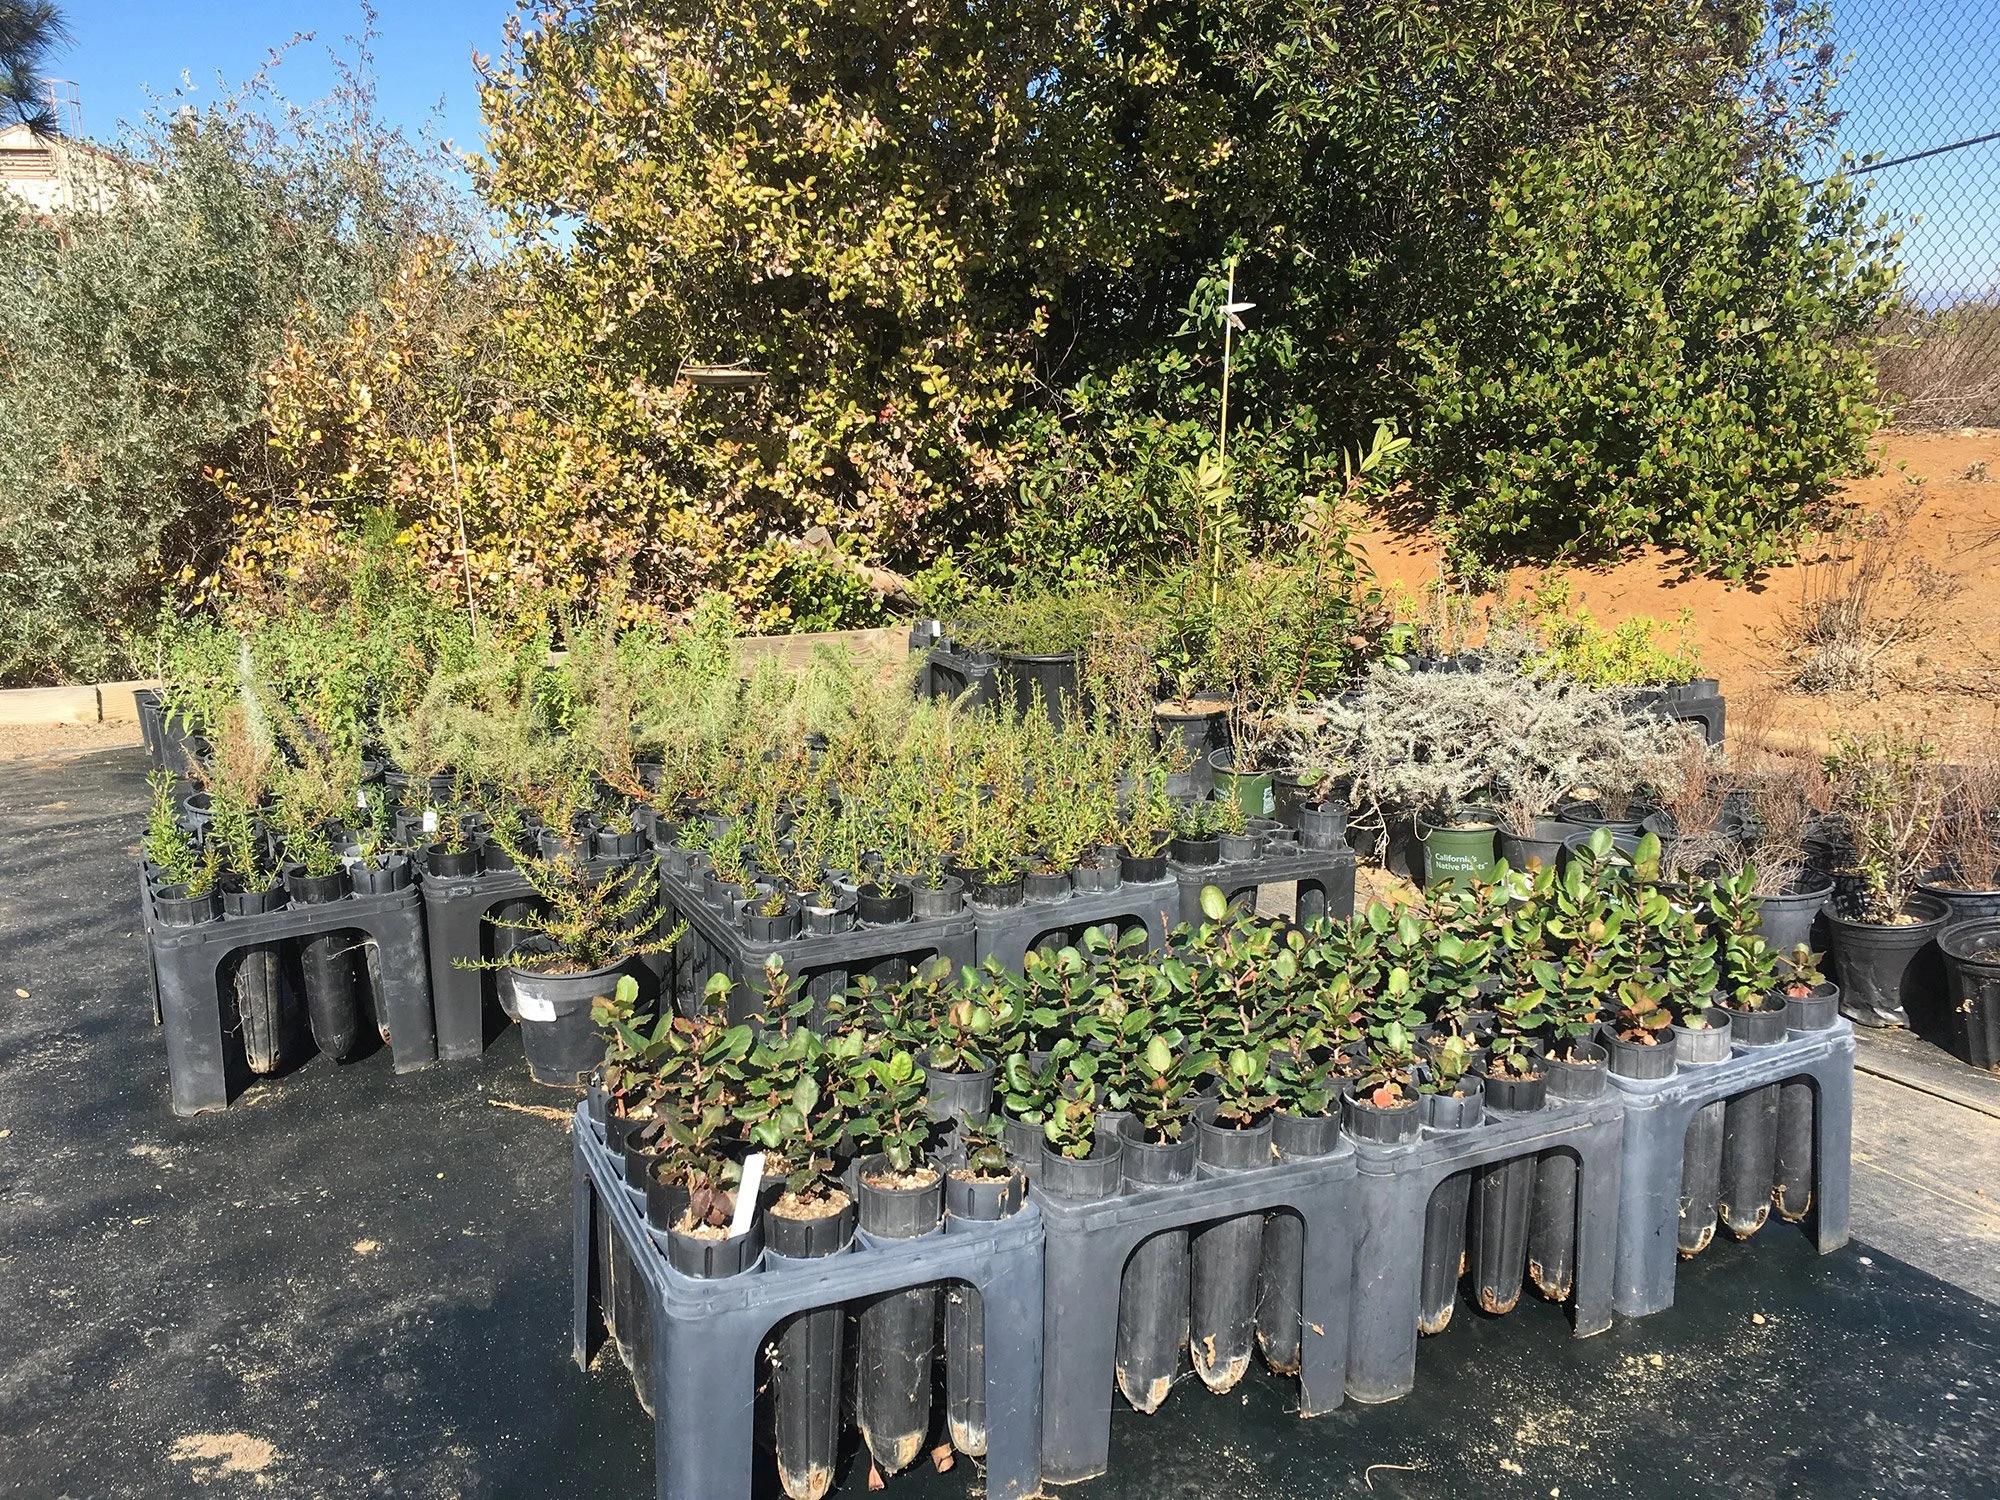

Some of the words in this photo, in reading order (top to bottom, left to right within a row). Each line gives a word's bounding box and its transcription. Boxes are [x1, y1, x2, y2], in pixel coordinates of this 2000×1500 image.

[1435, 853, 1478, 862] Californi's
[1435, 861, 1460, 870] Native
[1461, 863, 1485, 871] Plats
